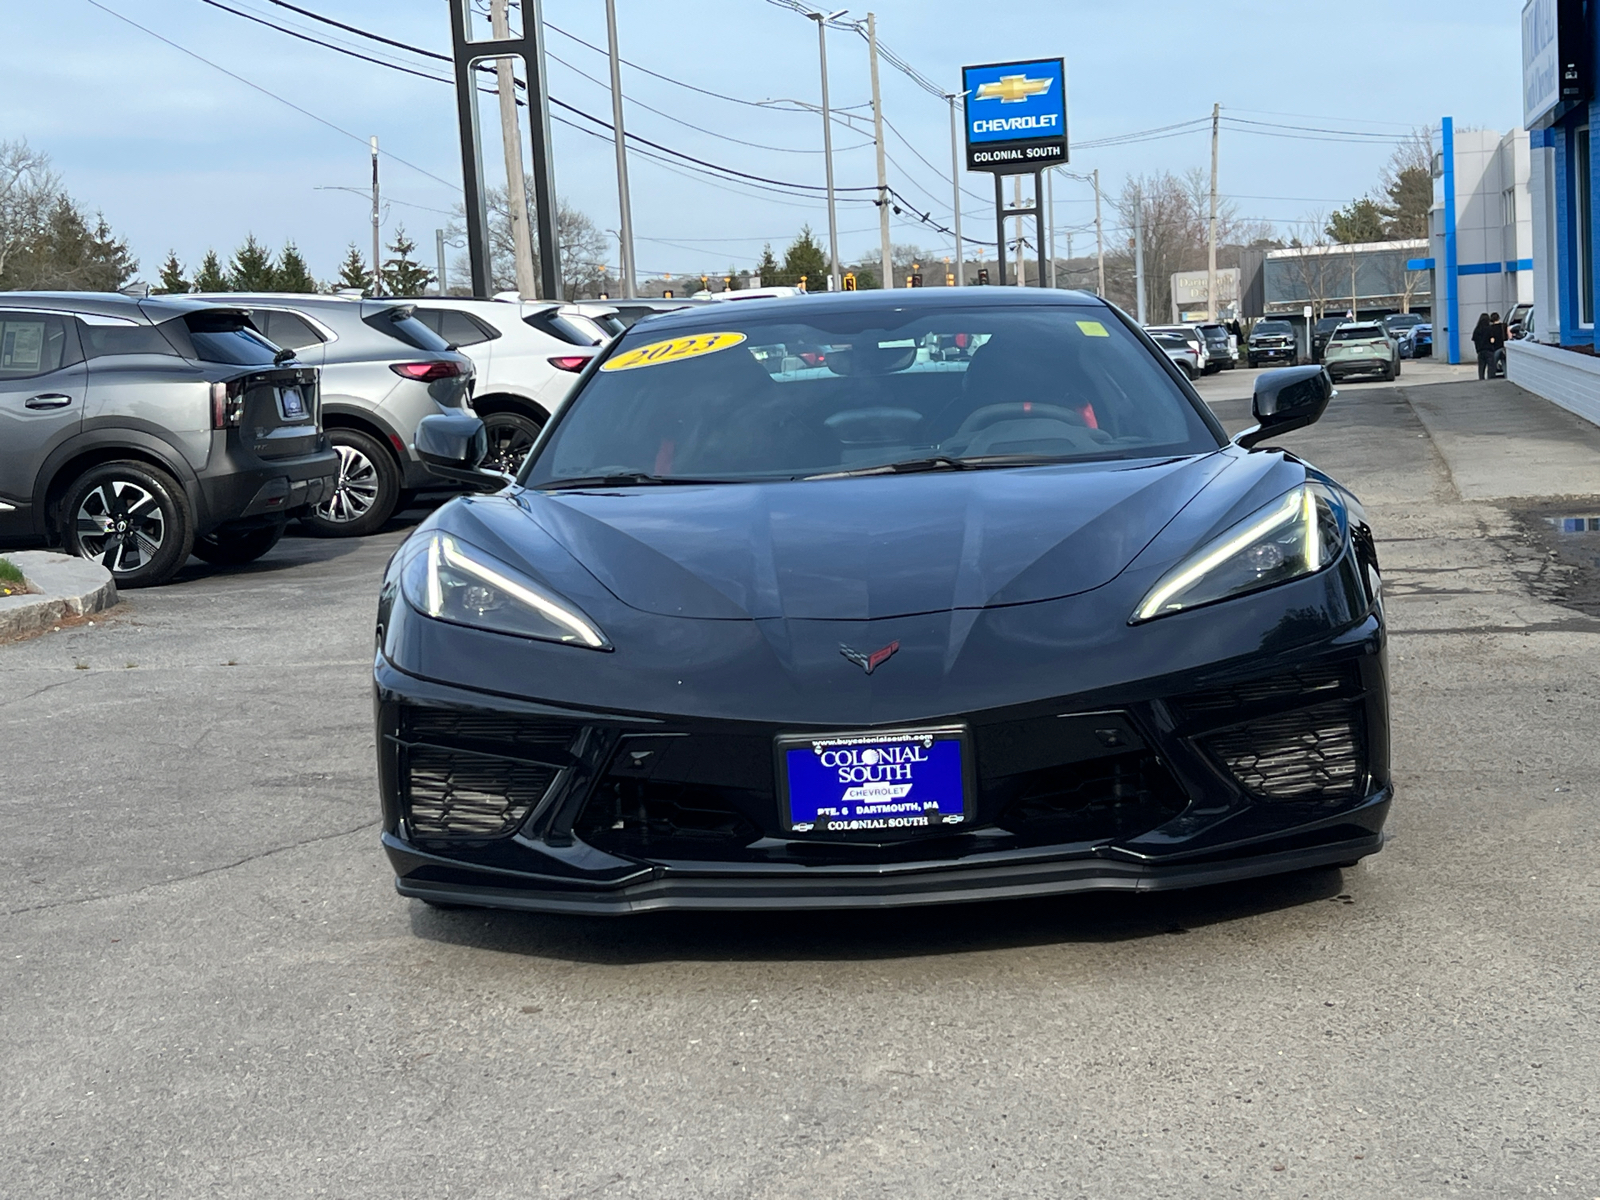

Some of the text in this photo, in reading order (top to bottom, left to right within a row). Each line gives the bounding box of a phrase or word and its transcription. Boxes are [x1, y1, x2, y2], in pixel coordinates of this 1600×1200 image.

[973, 114, 1058, 133] CHEVROLET
[974, 146, 1061, 162] COLONIAL SOUTH
[621, 335, 721, 367] 2023
[812, 734, 934, 748] www.buycolonialsouth.com
[820, 746, 929, 767] COLONIAL
[838, 763, 913, 783] SOUTH
[849, 787, 905, 797] CHEVROLET
[841, 807, 849, 815] 6
[856, 803, 922, 815] DARTMOUTH,
[923, 801, 939, 810] MA
[827, 816, 929, 830] COLONIAL SOUTH
